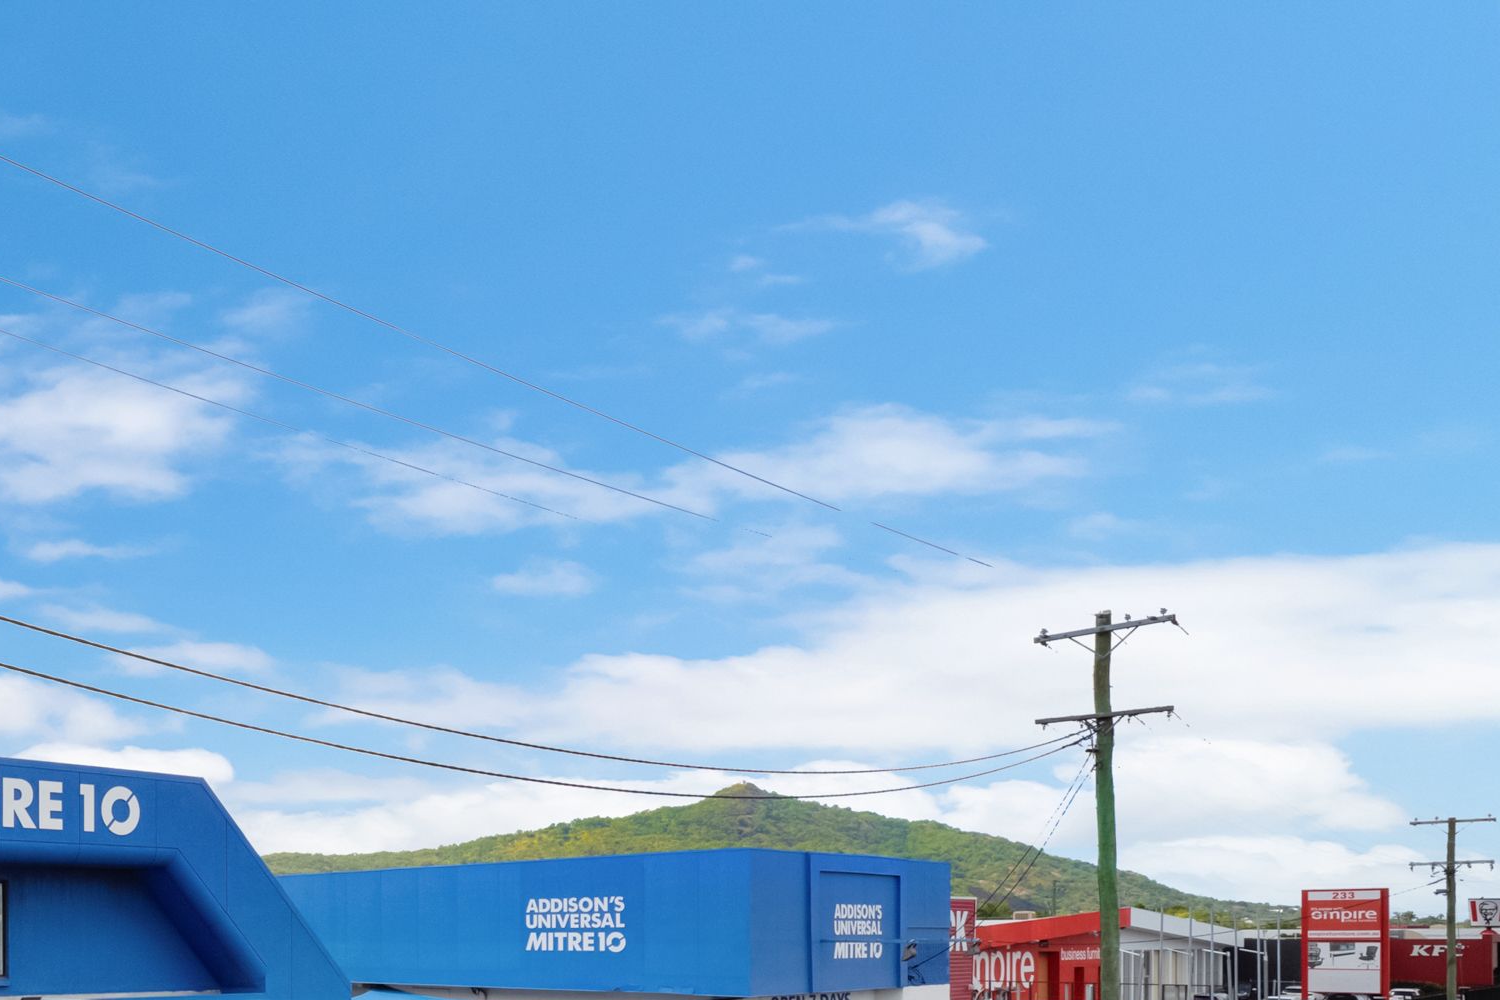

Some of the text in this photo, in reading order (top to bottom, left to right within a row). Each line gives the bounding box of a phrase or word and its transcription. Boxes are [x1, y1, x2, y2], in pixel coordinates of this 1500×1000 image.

[79, 783, 141, 836] 10
[1332, 891, 1355, 900] 233
[526, 896, 626, 914] ADDISON'S
[834, 903, 883, 920] ADDISON'S
[525, 913, 626, 929] UNIVERSAL
[1310, 909, 1378, 923] empire
[833, 920, 883, 936] UNIVERSAL
[525, 931, 627, 953] MITRE 10
[833, 942, 883, 959] MITRE 10
